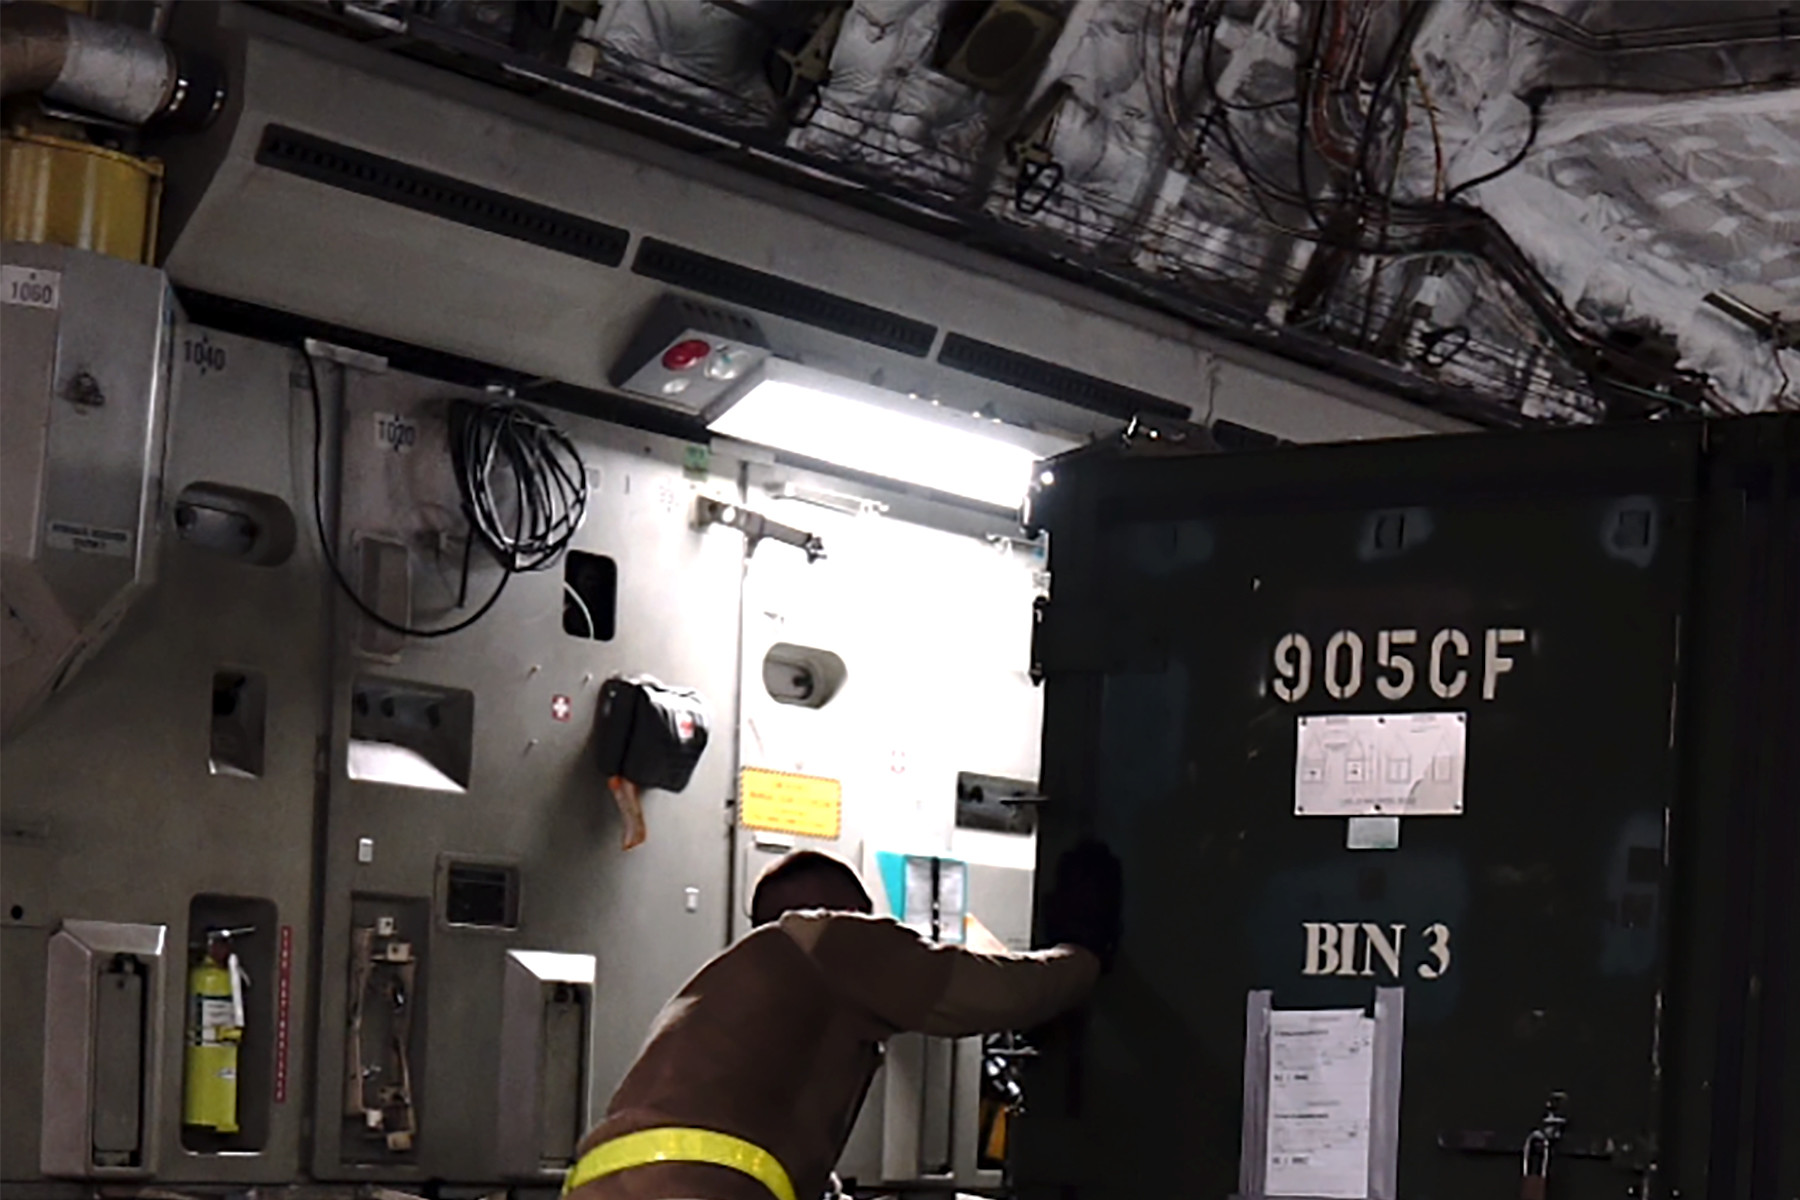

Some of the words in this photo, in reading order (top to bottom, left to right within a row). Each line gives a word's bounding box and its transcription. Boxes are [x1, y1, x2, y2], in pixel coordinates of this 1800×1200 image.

[1273, 628, 1525, 702] 905CF
[1301, 922, 1407, 978] BIN
[1417, 922, 1450, 979] 3
